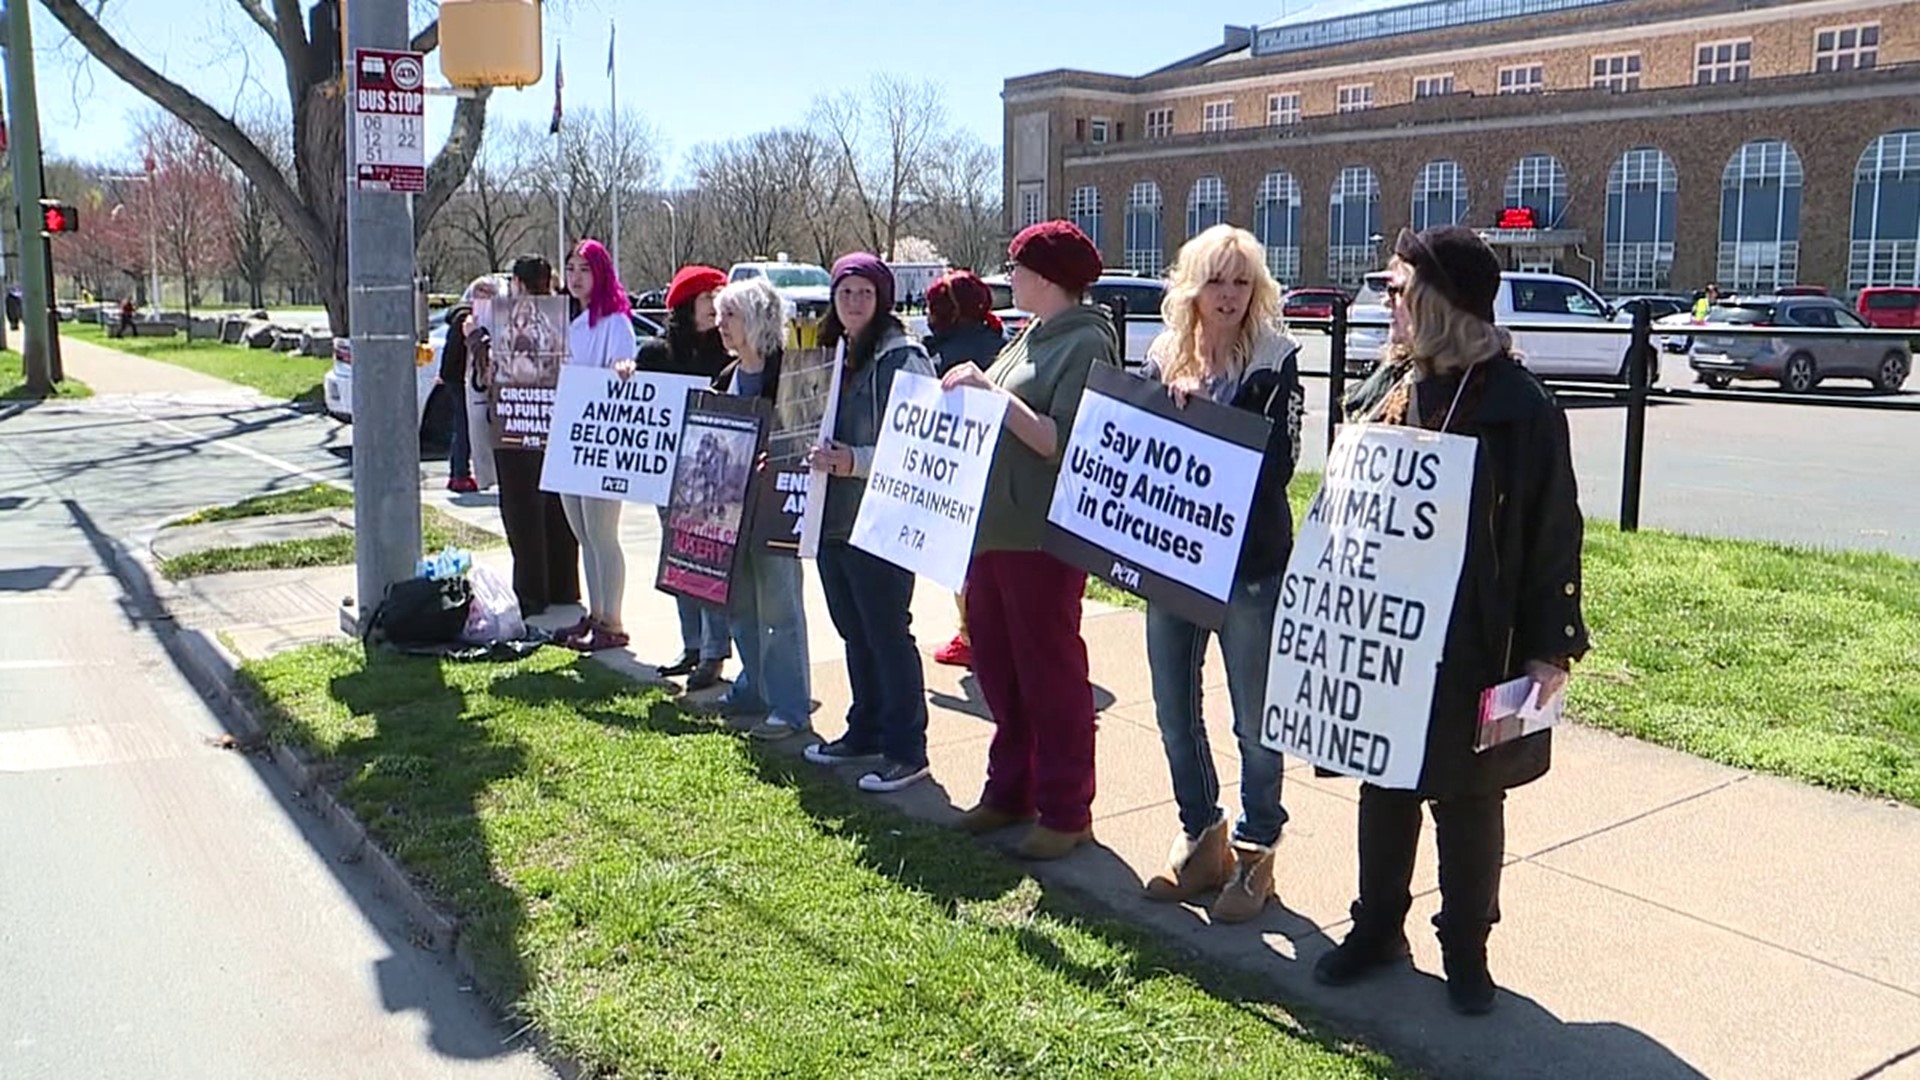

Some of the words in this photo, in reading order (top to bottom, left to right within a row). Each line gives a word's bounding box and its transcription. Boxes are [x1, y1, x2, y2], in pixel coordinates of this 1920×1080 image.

[359, 89, 386, 111] BUS
[388, 90, 422, 113] STOP
[364, 115, 382, 130] 06
[401, 117, 414, 131] 11
[365, 132, 381, 146] 12
[398, 133, 416, 148] 22
[366, 147, 382, 161] 51
[496, 402, 512, 417] NO
[514, 403, 539, 418] FUN
[500, 387, 555, 402] CIRCUSES
[607, 380, 656, 402] WILD
[505, 418, 549, 433] ANIMAL
[582, 401, 671, 428] ANIMALS
[893, 402, 990, 455] CRUELTY
[570, 423, 649, 449] BELONG
[655, 431, 677, 454] IN
[1100, 421, 1141, 463] Say
[1144, 438, 1182, 475] NO
[1185, 454, 1211, 488] to
[572, 446, 609, 468] THE
[615, 450, 667, 475] WILD
[902, 446, 917, 472] IS
[920, 453, 959, 485] NOT
[1328, 443, 1441, 491] CIRCUS
[871, 472, 975, 526] ENTERTAINMENT
[1071, 446, 1128, 498] Using
[1130, 473, 1235, 538] Animals
[1308, 485, 1438, 541] ANIMALS
[1076, 487, 1097, 520] in
[1101, 499, 1203, 565] Circuses
[1318, 534, 1381, 581] ARE
[1282, 572, 1426, 641] STARVED
[1277, 618, 1404, 686] BEATEN
[1296, 669, 1362, 722] AND
[1265, 704, 1391, 776] CHAINED
